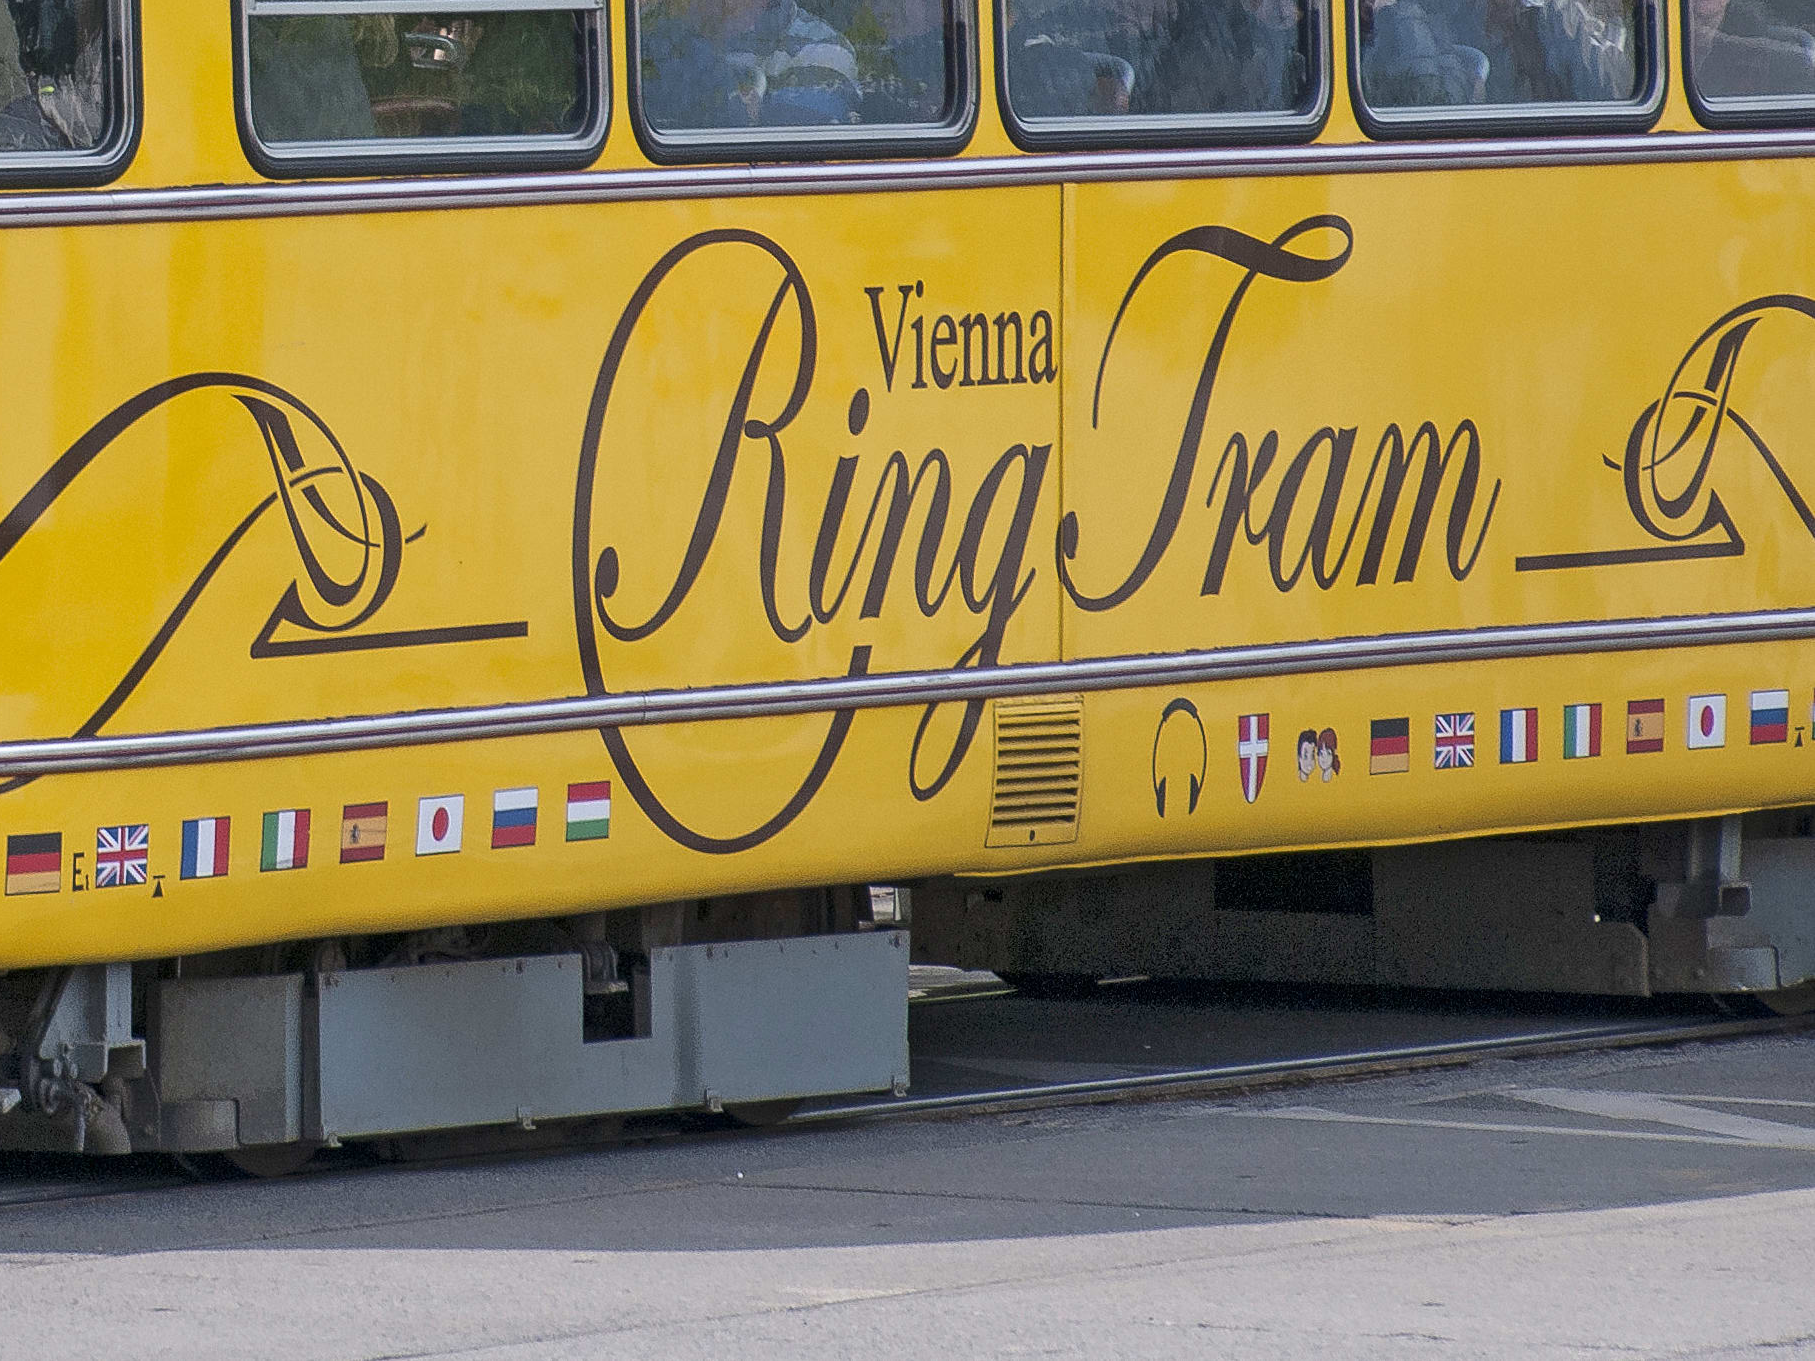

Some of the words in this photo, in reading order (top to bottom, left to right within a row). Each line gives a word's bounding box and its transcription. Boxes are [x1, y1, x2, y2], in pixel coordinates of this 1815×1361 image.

[865, 279, 1058, 392] Vienna
[573, 228, 1053, 855] Ring
[1055, 213, 1502, 612] Tram
